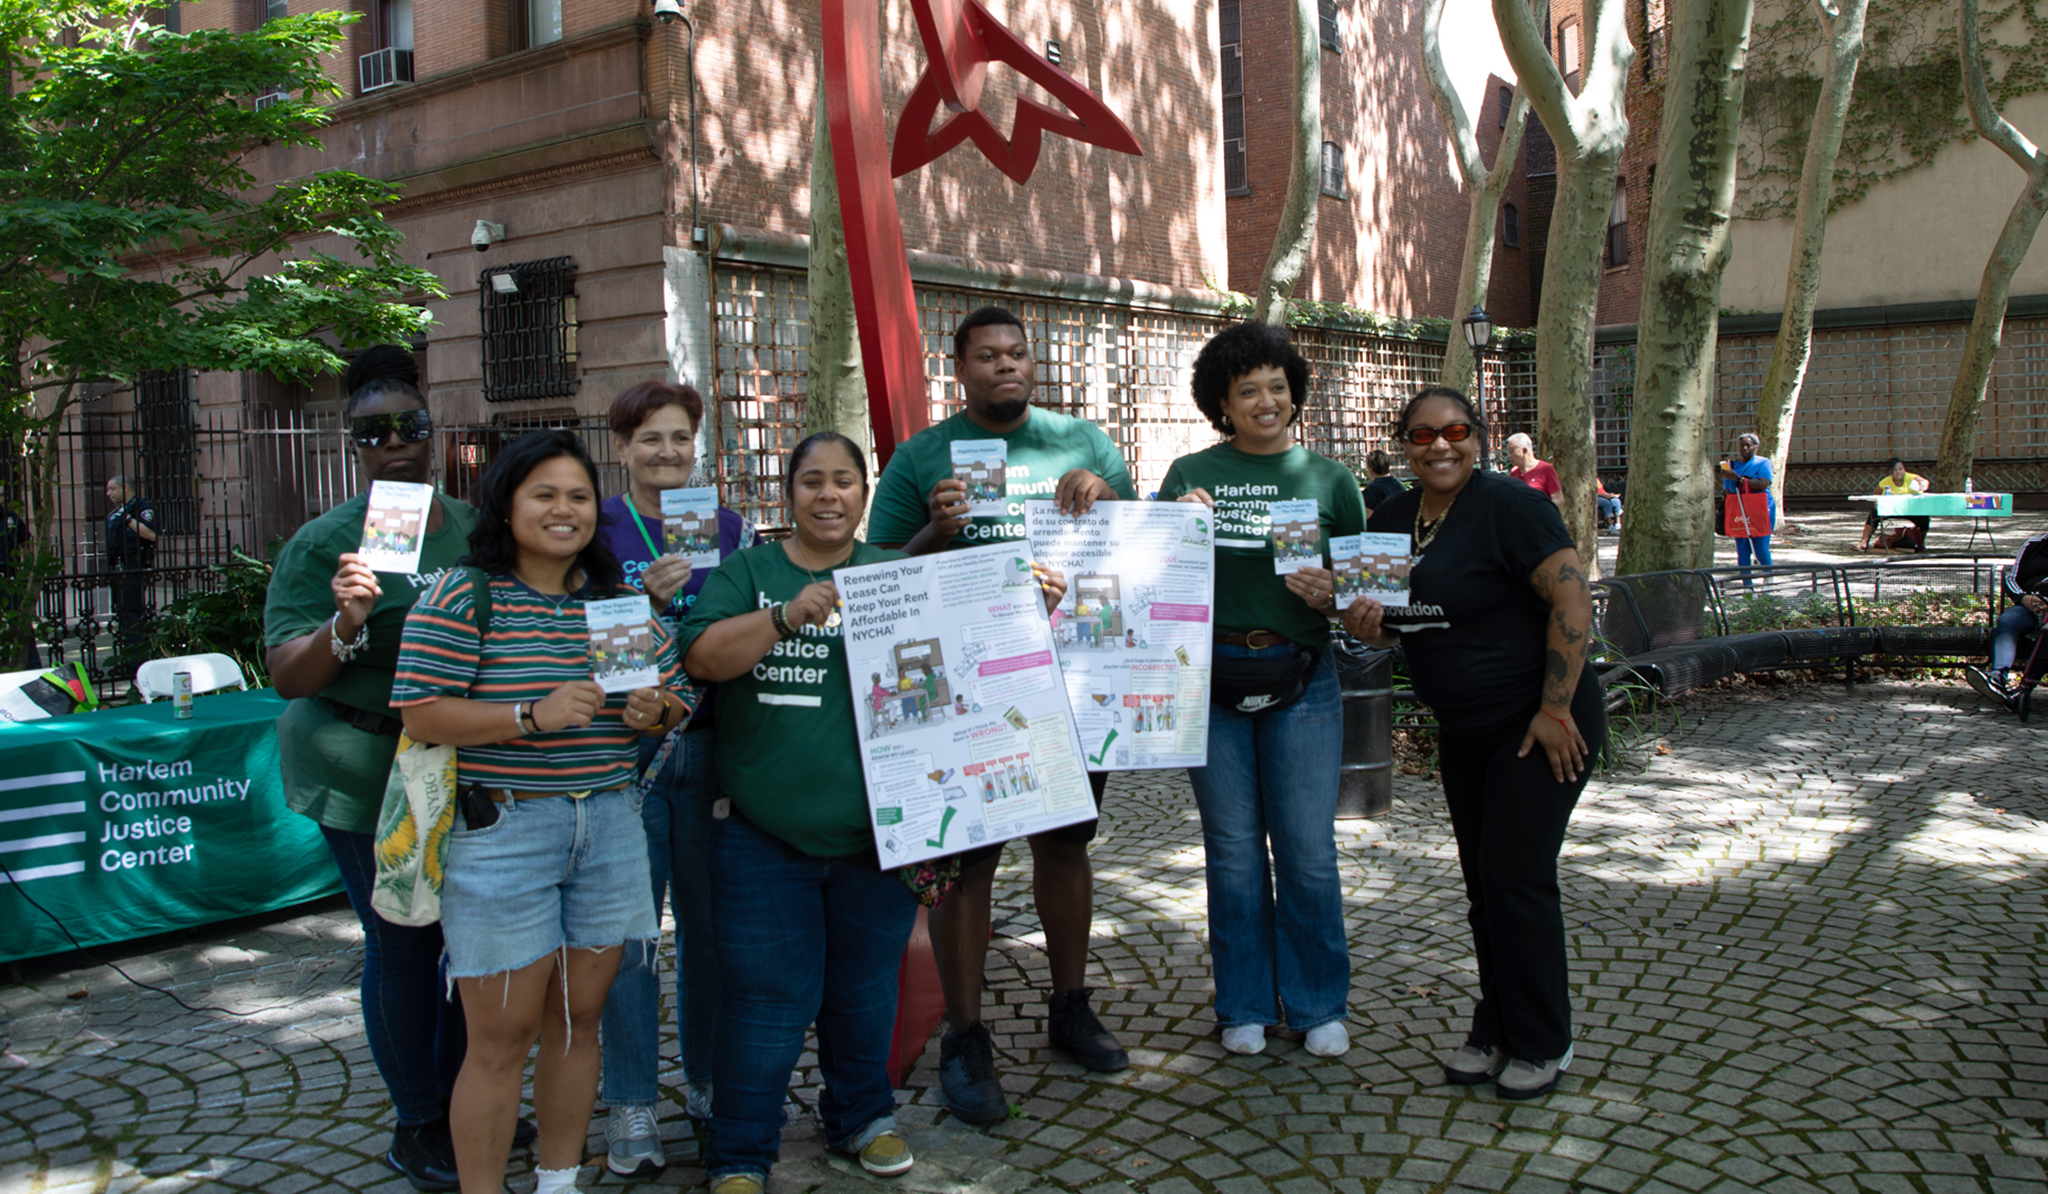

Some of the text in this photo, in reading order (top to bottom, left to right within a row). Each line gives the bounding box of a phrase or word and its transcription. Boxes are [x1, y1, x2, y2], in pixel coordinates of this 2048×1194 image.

[463, 446, 483, 463] EXIT
[1215, 483, 1278, 497] Harlem
[963, 521, 1025, 540] Cente
[1033, 528, 1100, 536] arrendamiento
[1034, 539, 1061, 548] puede
[1034, 550, 1068, 559] alquiler
[843, 565, 924, 586] Renewing Your
[846, 583, 900, 600] Lease Can
[848, 591, 929, 614] Keep Your Rent
[988, 603, 1011, 613] WHAT
[851, 607, 920, 628] Affordable In
[852, 624, 895, 642] NYCHA!
[766, 638, 830, 659] stice
[753, 663, 828, 684] Center
[1131, 663, 1177, 671] INCORRECTO?
[1242, 694, 1272, 707] NIKE
[970, 723, 1007, 739] WRONG?
[870, 744, 891, 755] HOW
[98, 759, 193, 783] Harlem
[99, 777, 251, 813] Community
[422, 771, 442, 819] NYBG
[100, 814, 192, 843] Justice
[100, 843, 195, 872] Center
